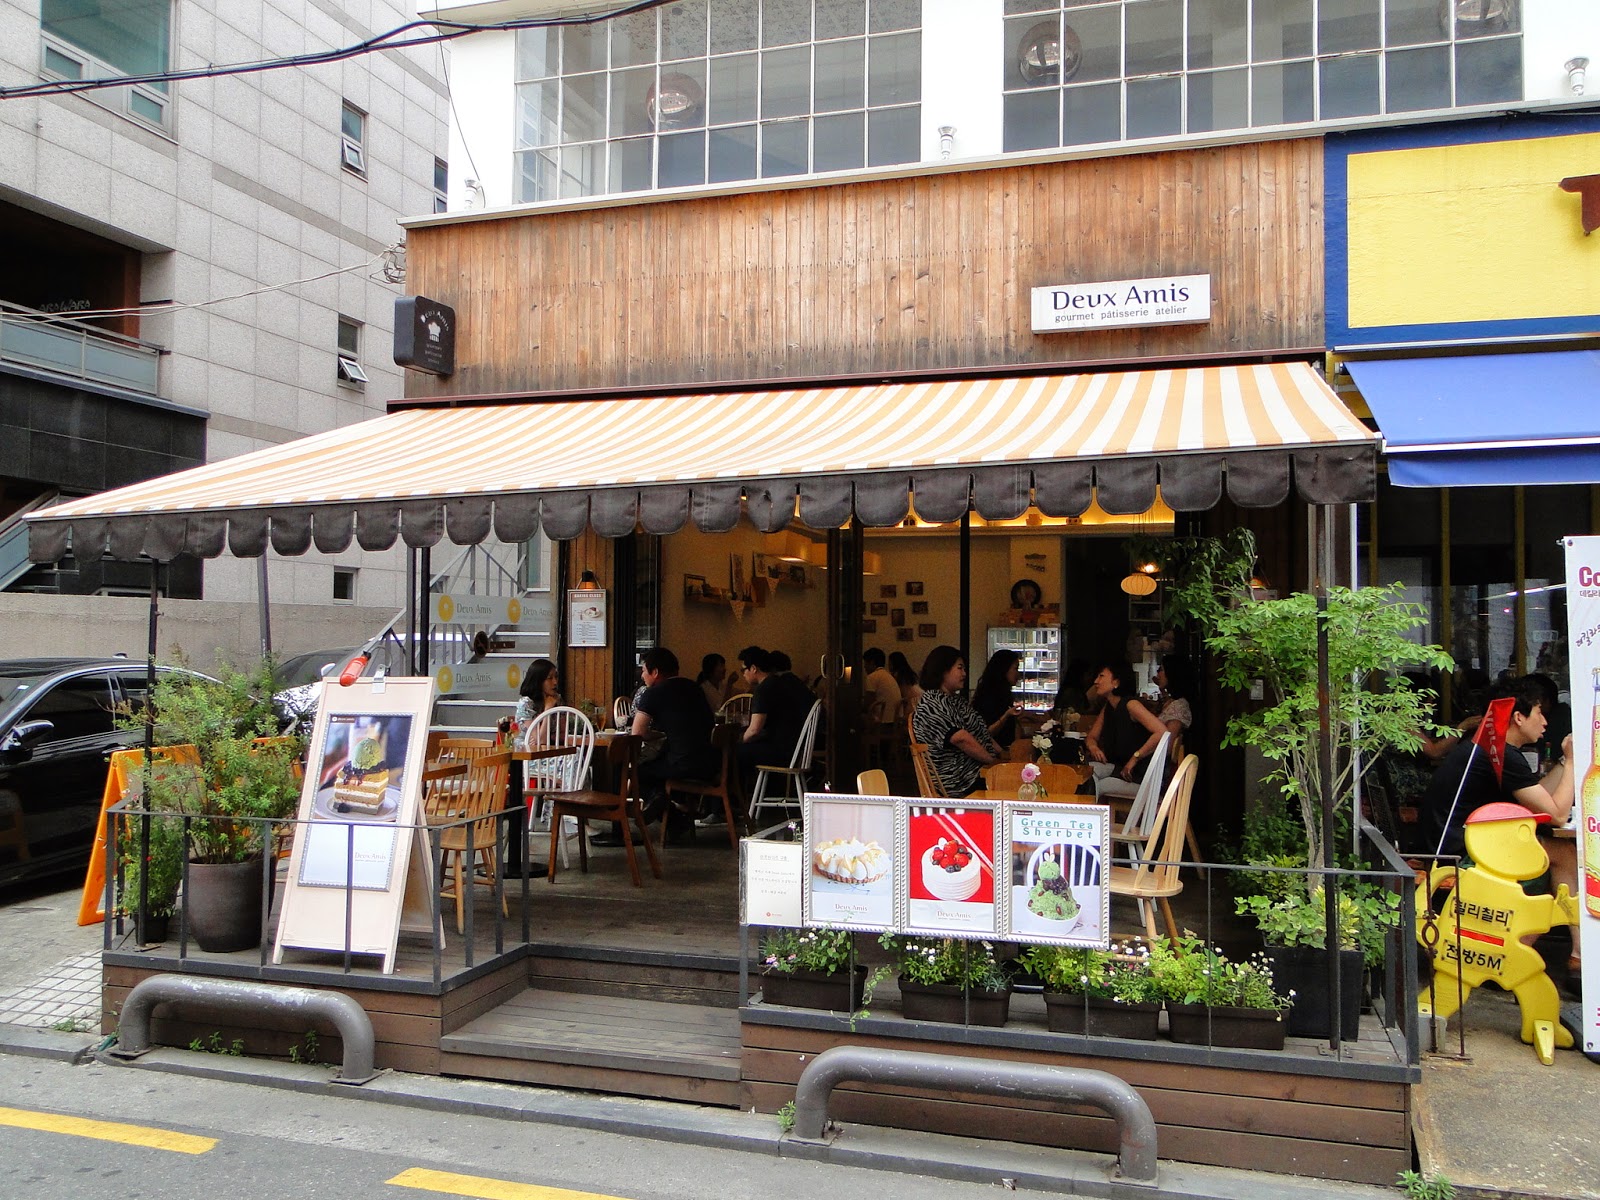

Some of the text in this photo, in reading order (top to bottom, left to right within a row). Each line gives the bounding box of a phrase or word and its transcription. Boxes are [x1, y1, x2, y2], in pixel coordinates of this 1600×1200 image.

[1051, 283, 1190, 310] Deux Amis
[1055, 306, 1188, 323] gourmet pâtisserie atelier
[456, 602, 492, 615] Deux Amis
[1021, 818, 1093, 830] Green Tea
[1022, 827, 1092, 838] Sherbet
